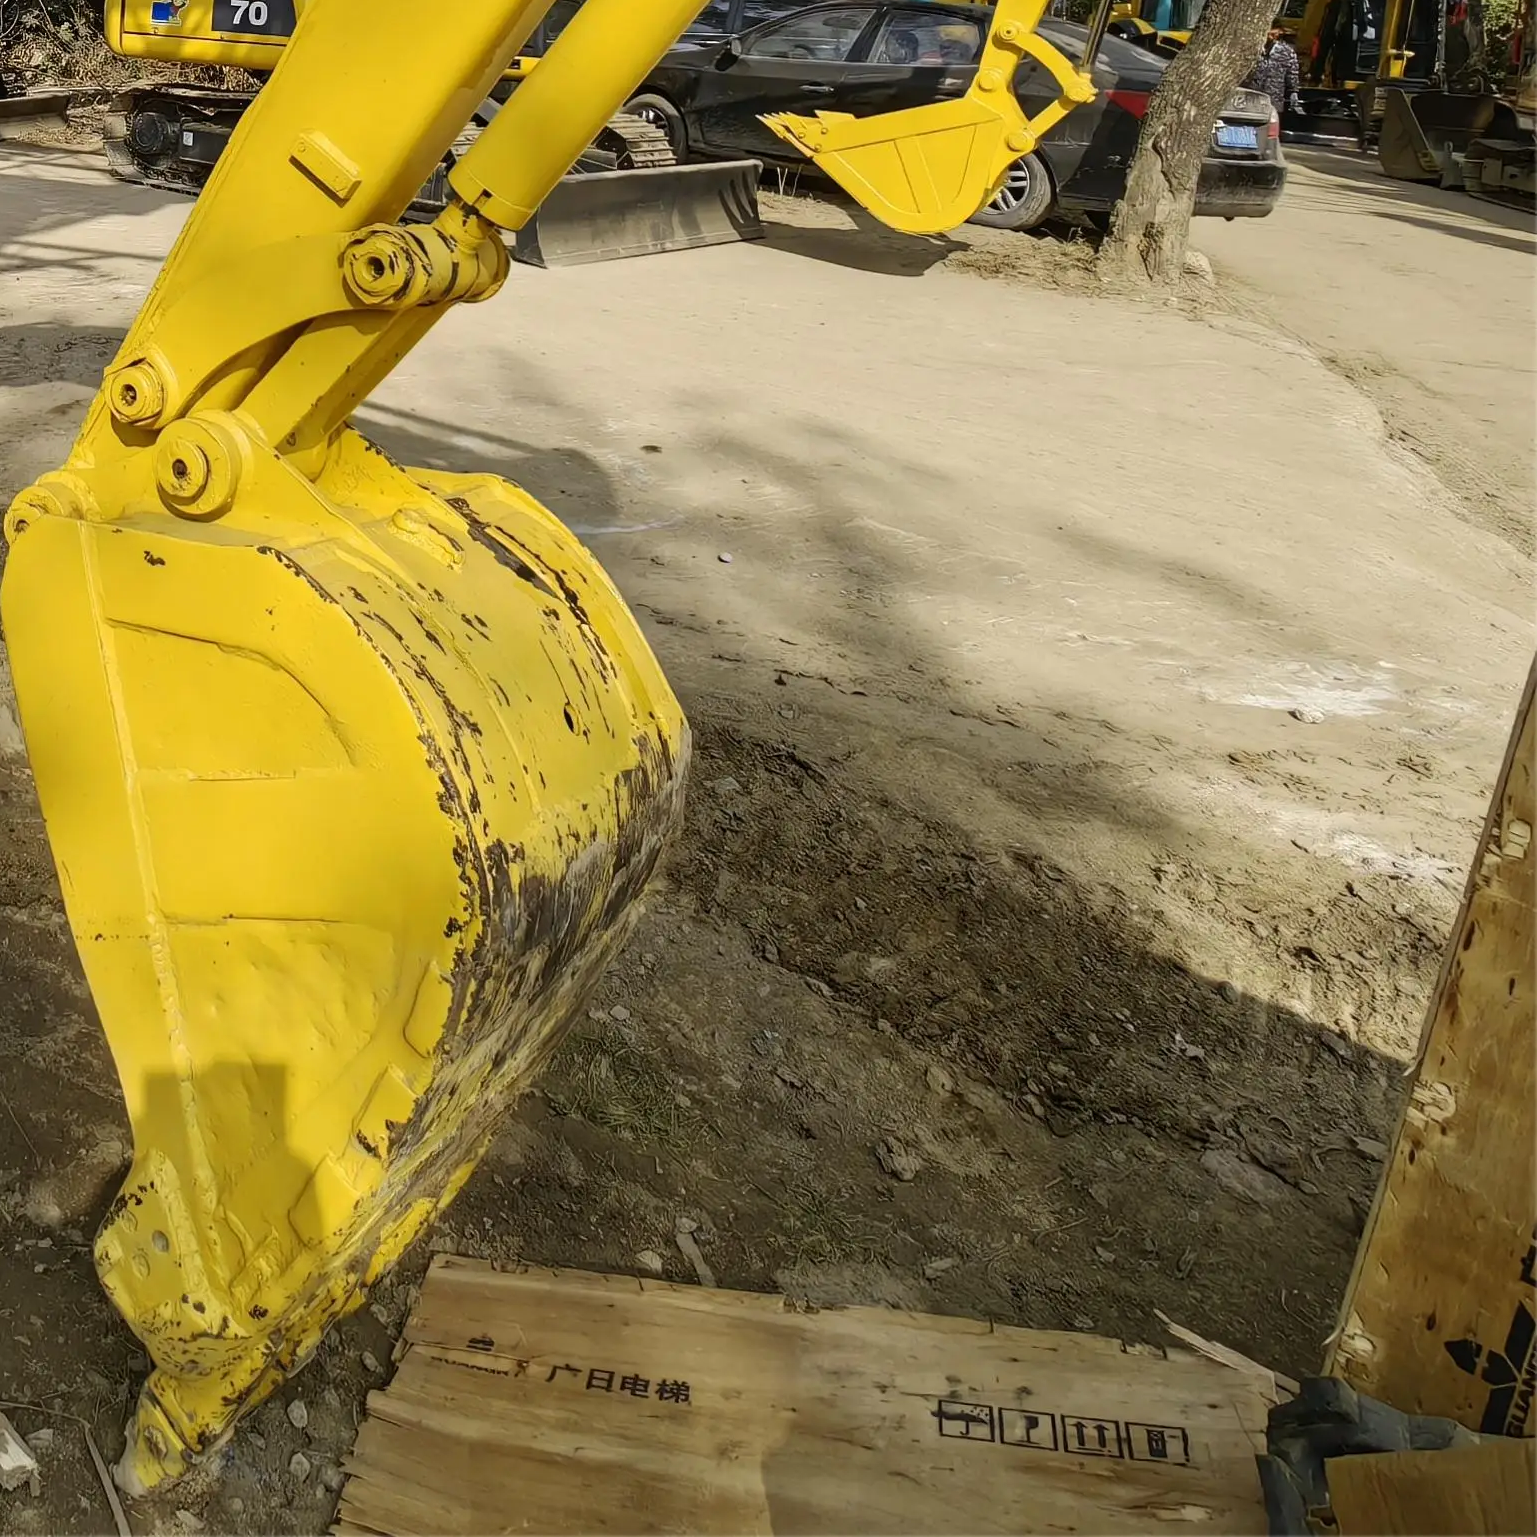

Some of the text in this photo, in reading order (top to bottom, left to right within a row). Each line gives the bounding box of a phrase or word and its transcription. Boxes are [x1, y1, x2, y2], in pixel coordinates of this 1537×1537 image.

[230, 0, 268, 26] 70
[546, 1363, 691, 1404] 广日电梯
